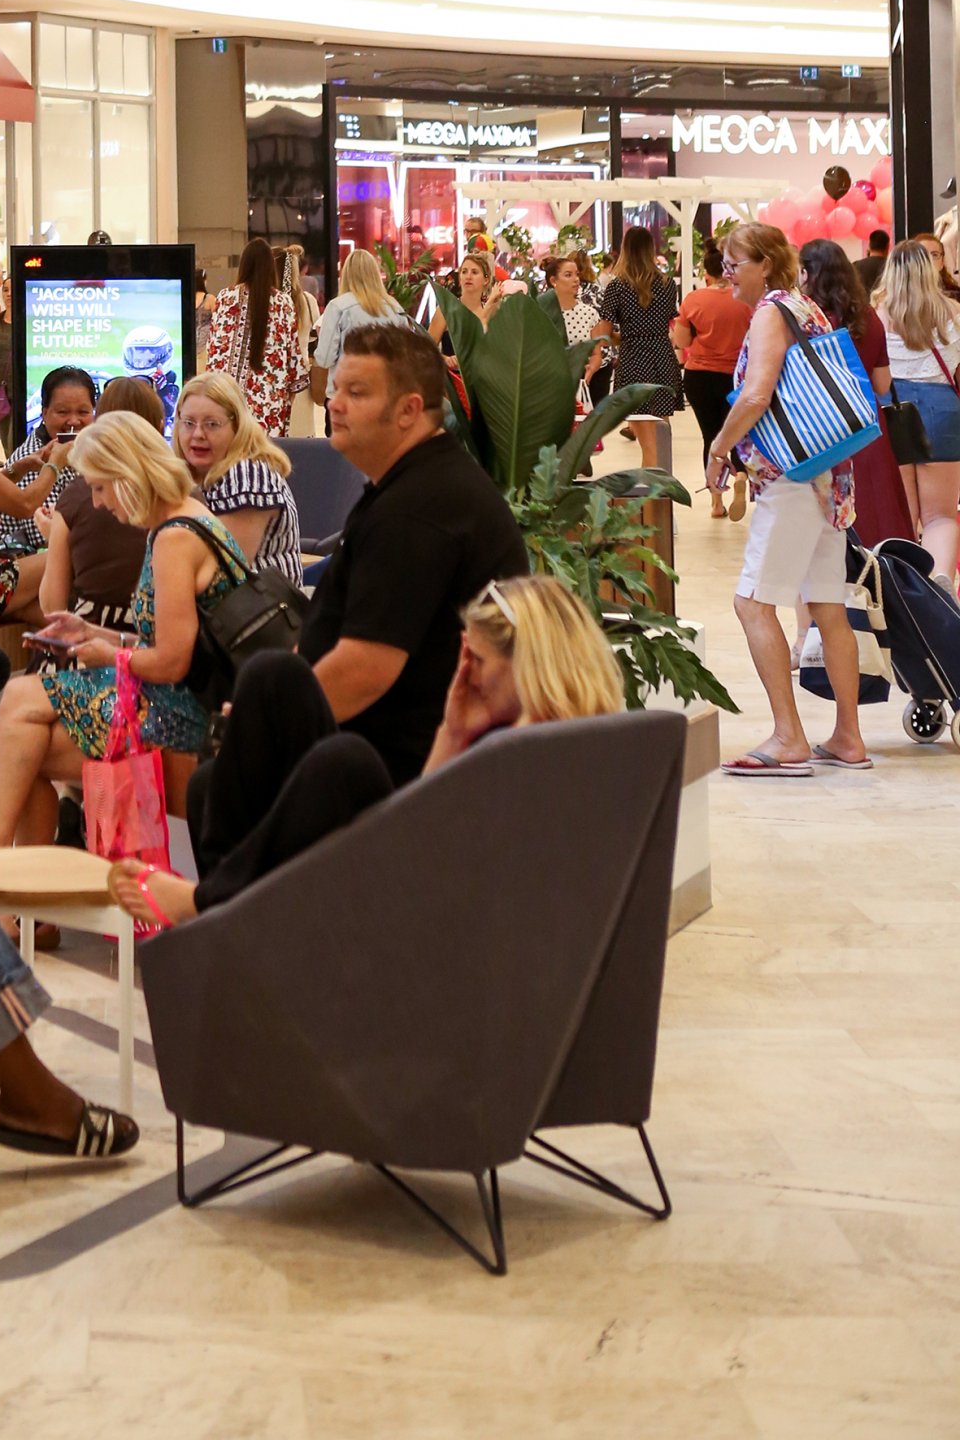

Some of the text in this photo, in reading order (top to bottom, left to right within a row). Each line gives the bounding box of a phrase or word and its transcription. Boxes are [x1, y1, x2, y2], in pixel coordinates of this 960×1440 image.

[468, 124, 531, 147] MAXIMA
[672, 114, 798, 155] MECCA
[32, 304, 115, 317] WISH WILL
[32, 319, 112, 333] SHAPE HIS
